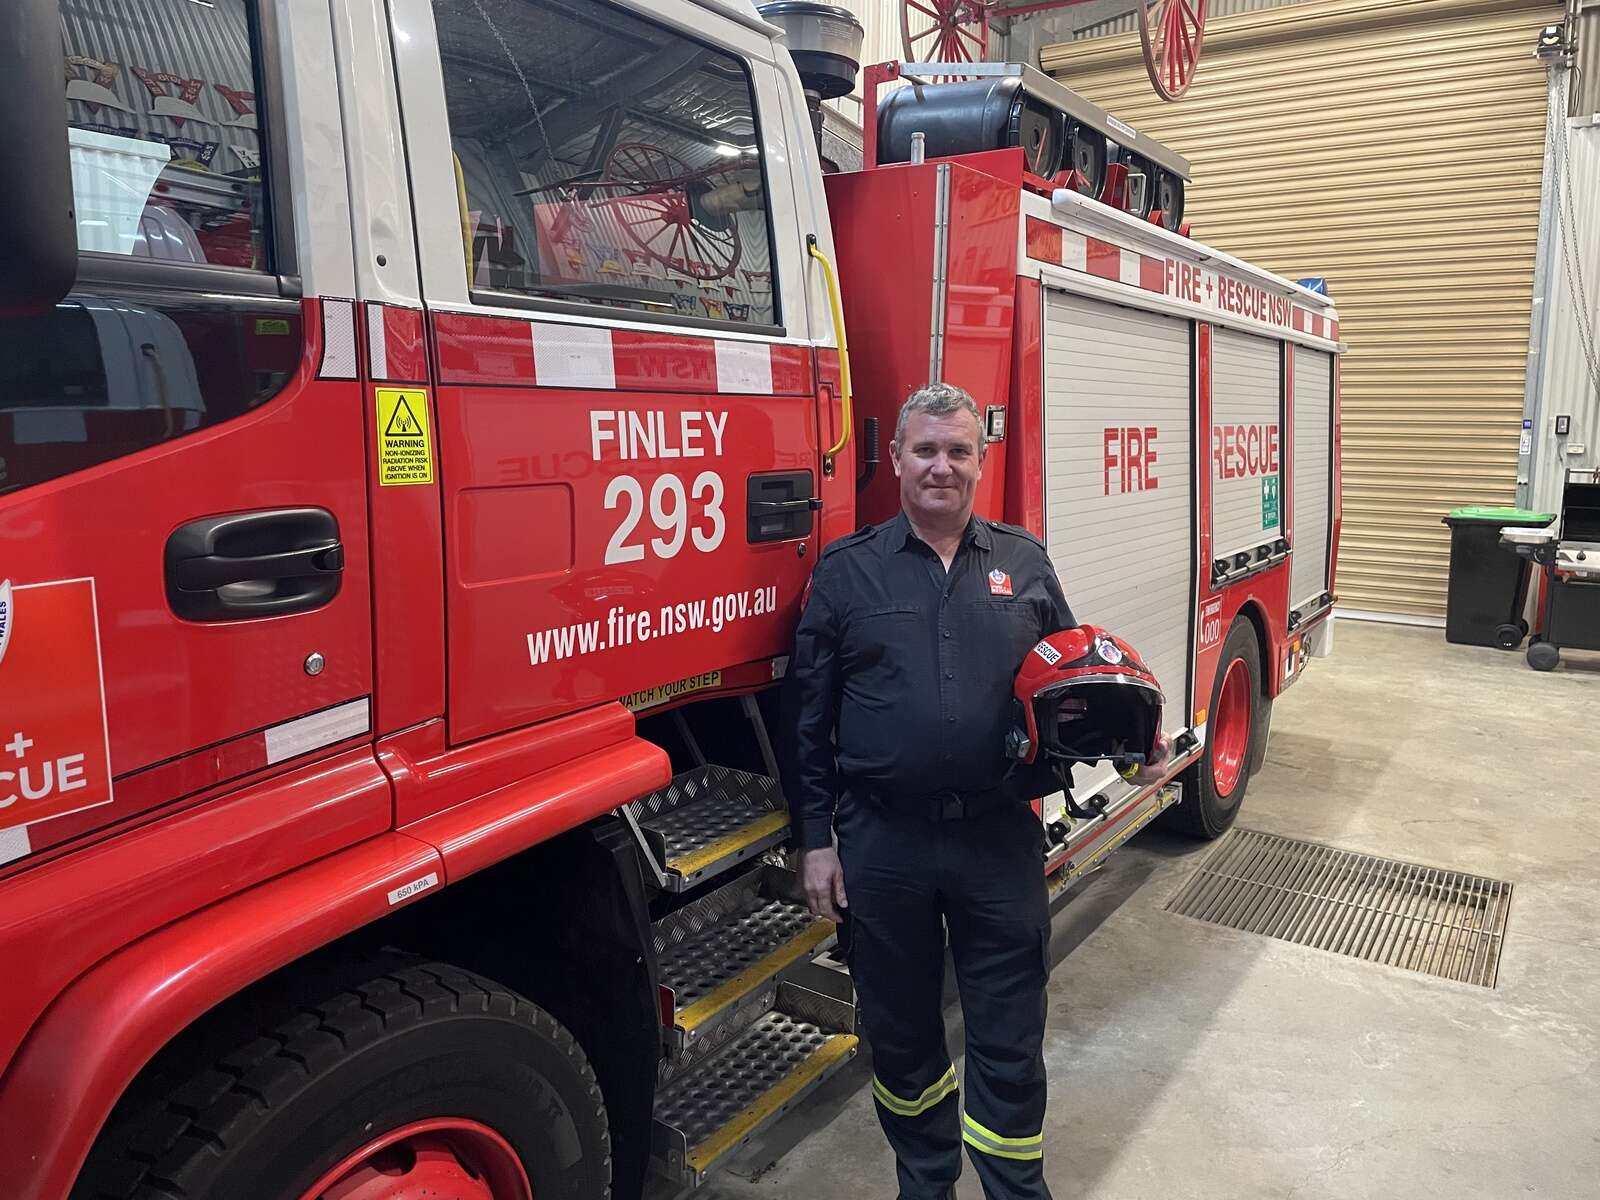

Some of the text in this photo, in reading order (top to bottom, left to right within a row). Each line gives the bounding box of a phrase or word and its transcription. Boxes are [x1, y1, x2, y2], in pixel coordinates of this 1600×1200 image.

[1165, 257, 1201, 303] FIRE
[1218, 275, 1267, 322] RESCUE
[1268, 294, 1292, 328] NSW
[383, 457, 413, 465] RADIATION
[385, 439, 425, 448] WARNING
[589, 410, 729, 461] FINLEY
[1213, 425, 1278, 480] RESCUE
[1103, 427, 1159, 496] FIRE
[604, 470, 726, 565] 293
[526, 586, 777, 666] www.fire.nsw.gov.au
[1204, 618, 1220, 645] 000
[656, 679, 687, 698] YOUR
[689, 671, 719, 689] STEP
[397, 879, 430, 898] 650 kPA
